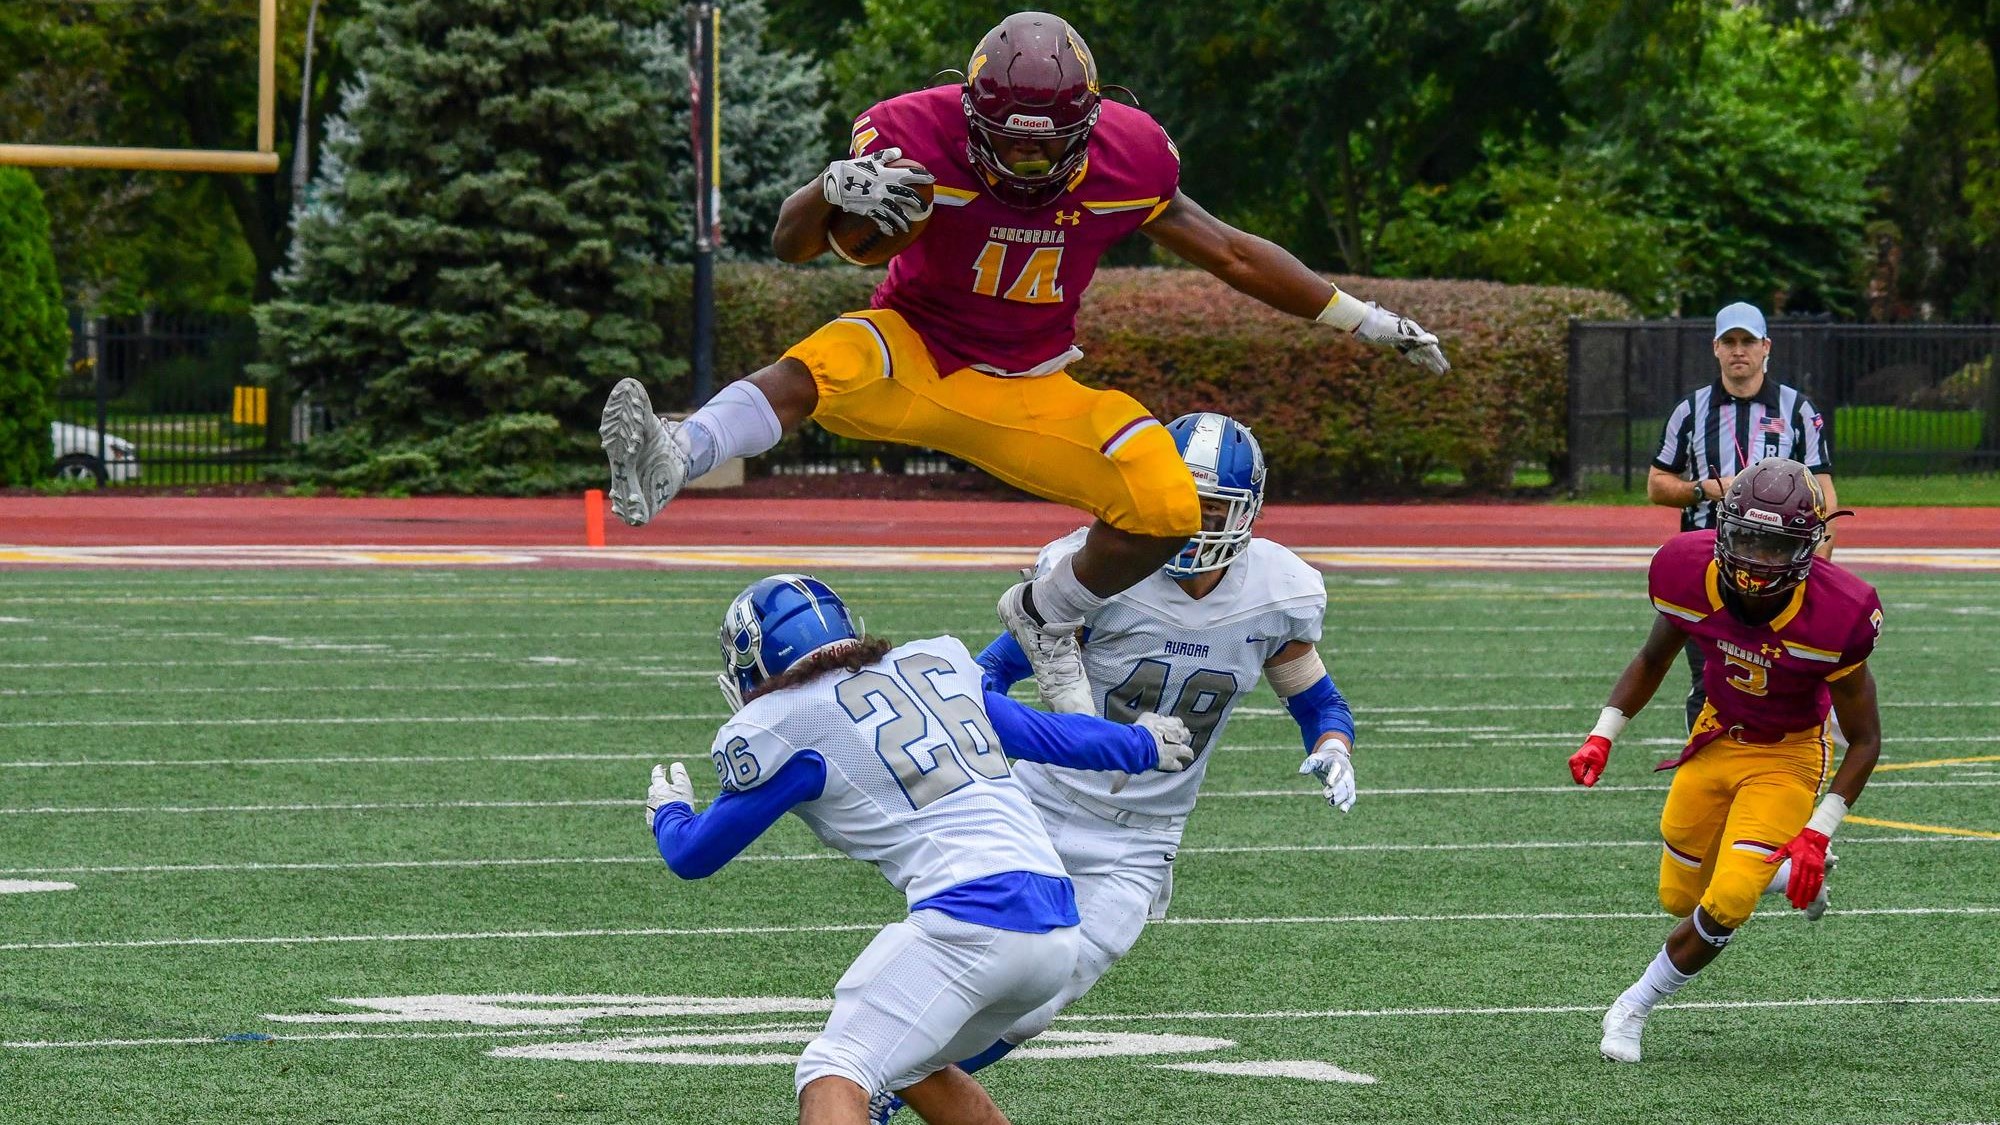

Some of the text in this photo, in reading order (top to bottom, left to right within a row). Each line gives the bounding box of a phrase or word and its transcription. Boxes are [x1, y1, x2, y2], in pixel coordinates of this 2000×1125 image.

[1013, 117, 1049, 128] Riddell
[989, 226, 1065, 244] CONCORDIA
[972, 240, 1064, 304] 14
[1766, 444, 1777, 458] R
[1749, 510, 1778, 523] Riddell
[1164, 640, 1210, 658] AURORA
[1716, 639, 1772, 669] CONCORDIA
[1724, 653, 1769, 697] 3
[833, 652, 1011, 811] 26
[712, 735, 762, 792] 26
